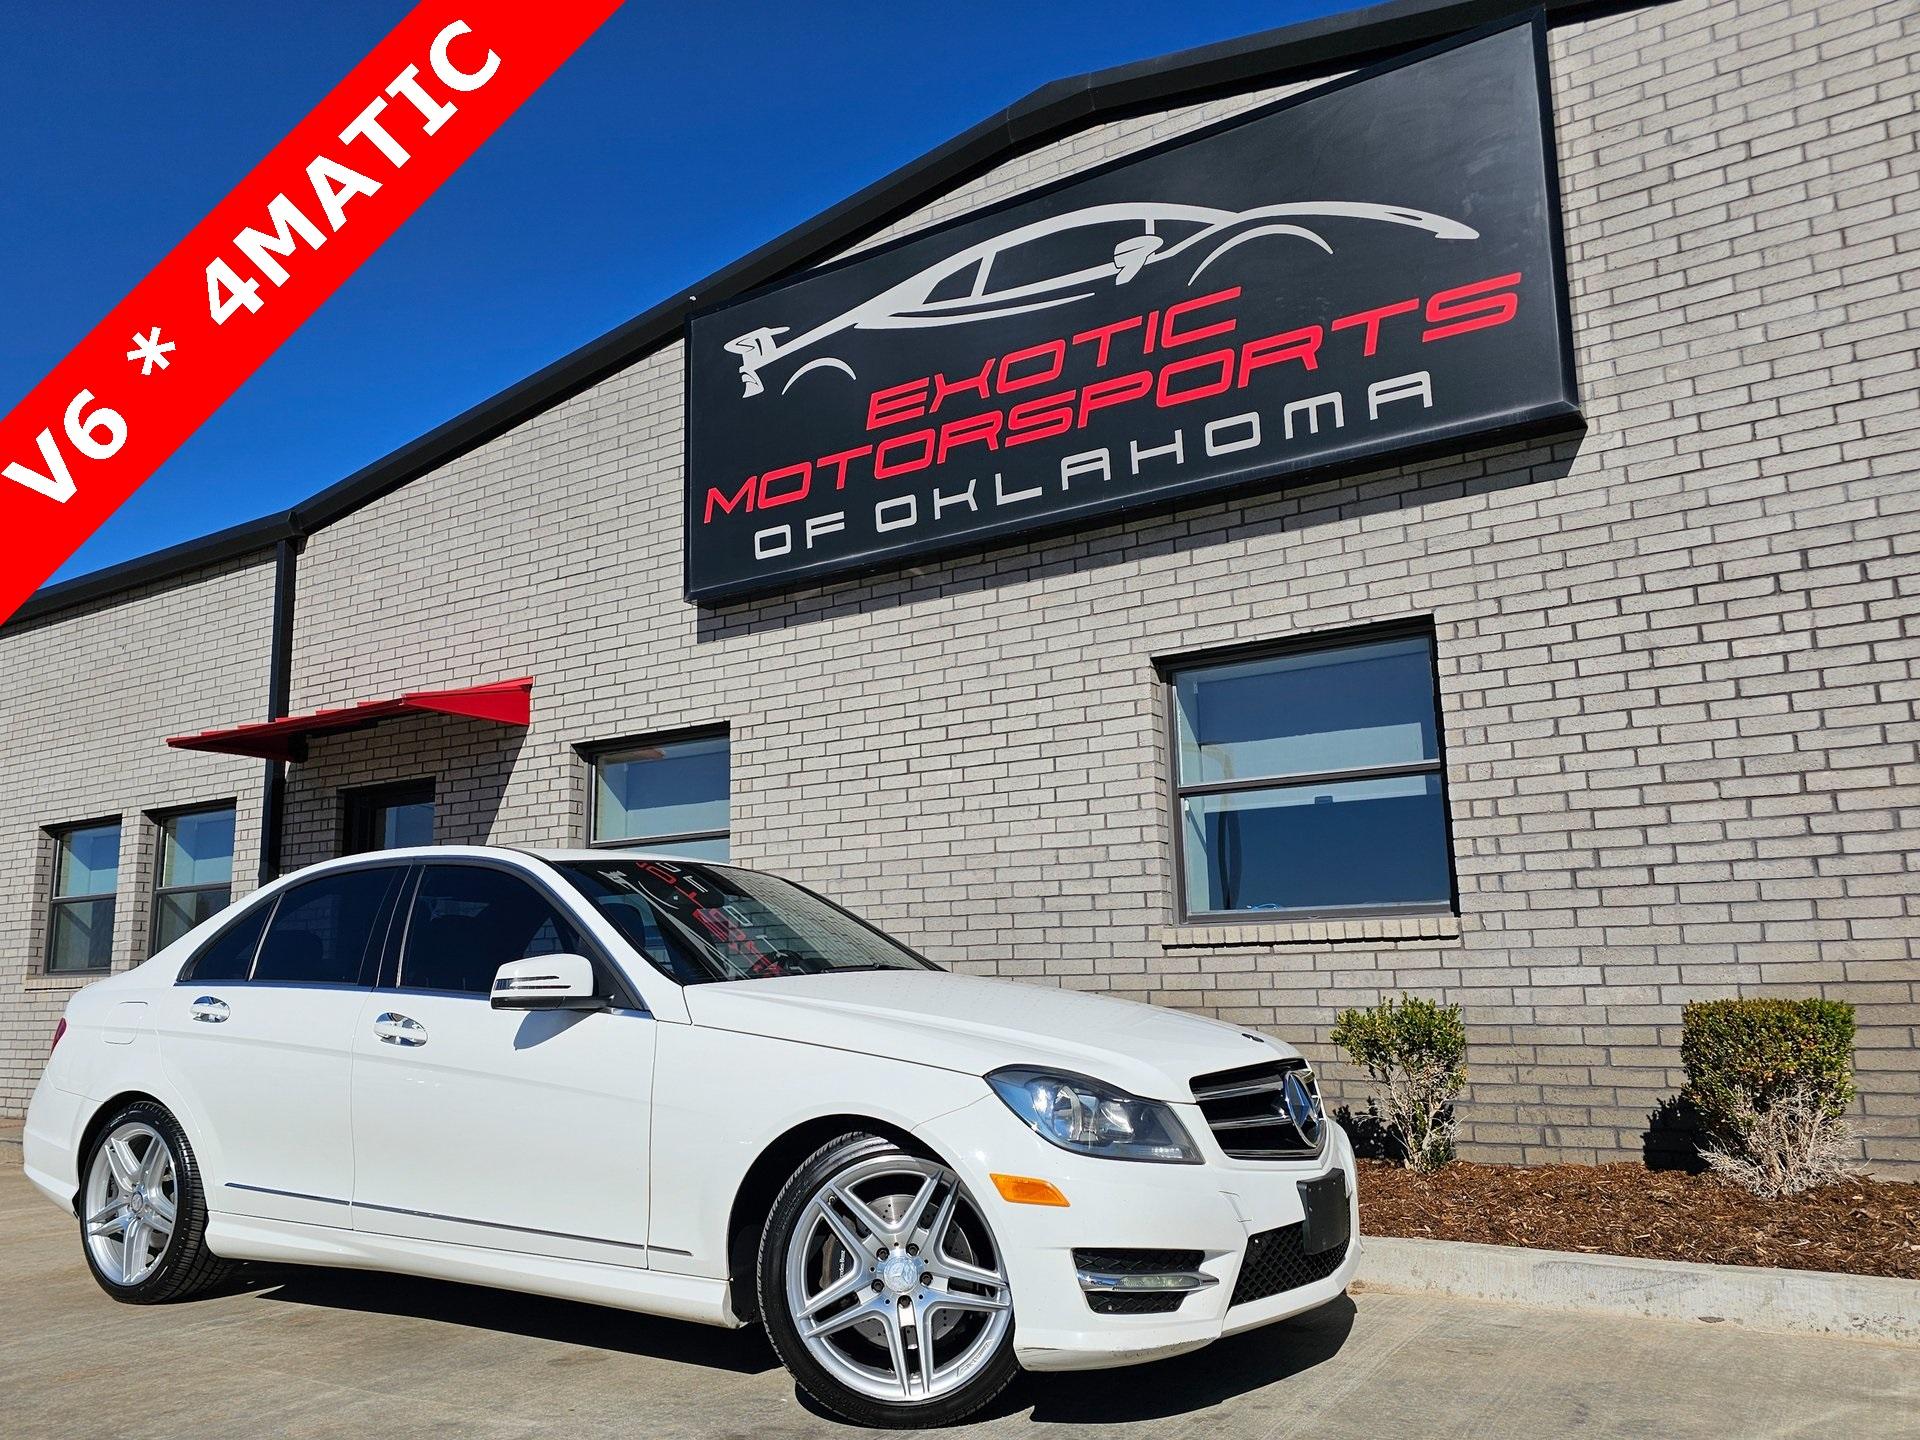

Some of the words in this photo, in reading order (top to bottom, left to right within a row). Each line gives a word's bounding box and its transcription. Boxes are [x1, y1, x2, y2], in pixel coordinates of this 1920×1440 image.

[703, 271, 1522, 524] MOTORSPORTS
[866, 286, 1242, 431] EXOTIC
[754, 511, 845, 560] OF
[875, 370, 1433, 533] OKLAHOMA
